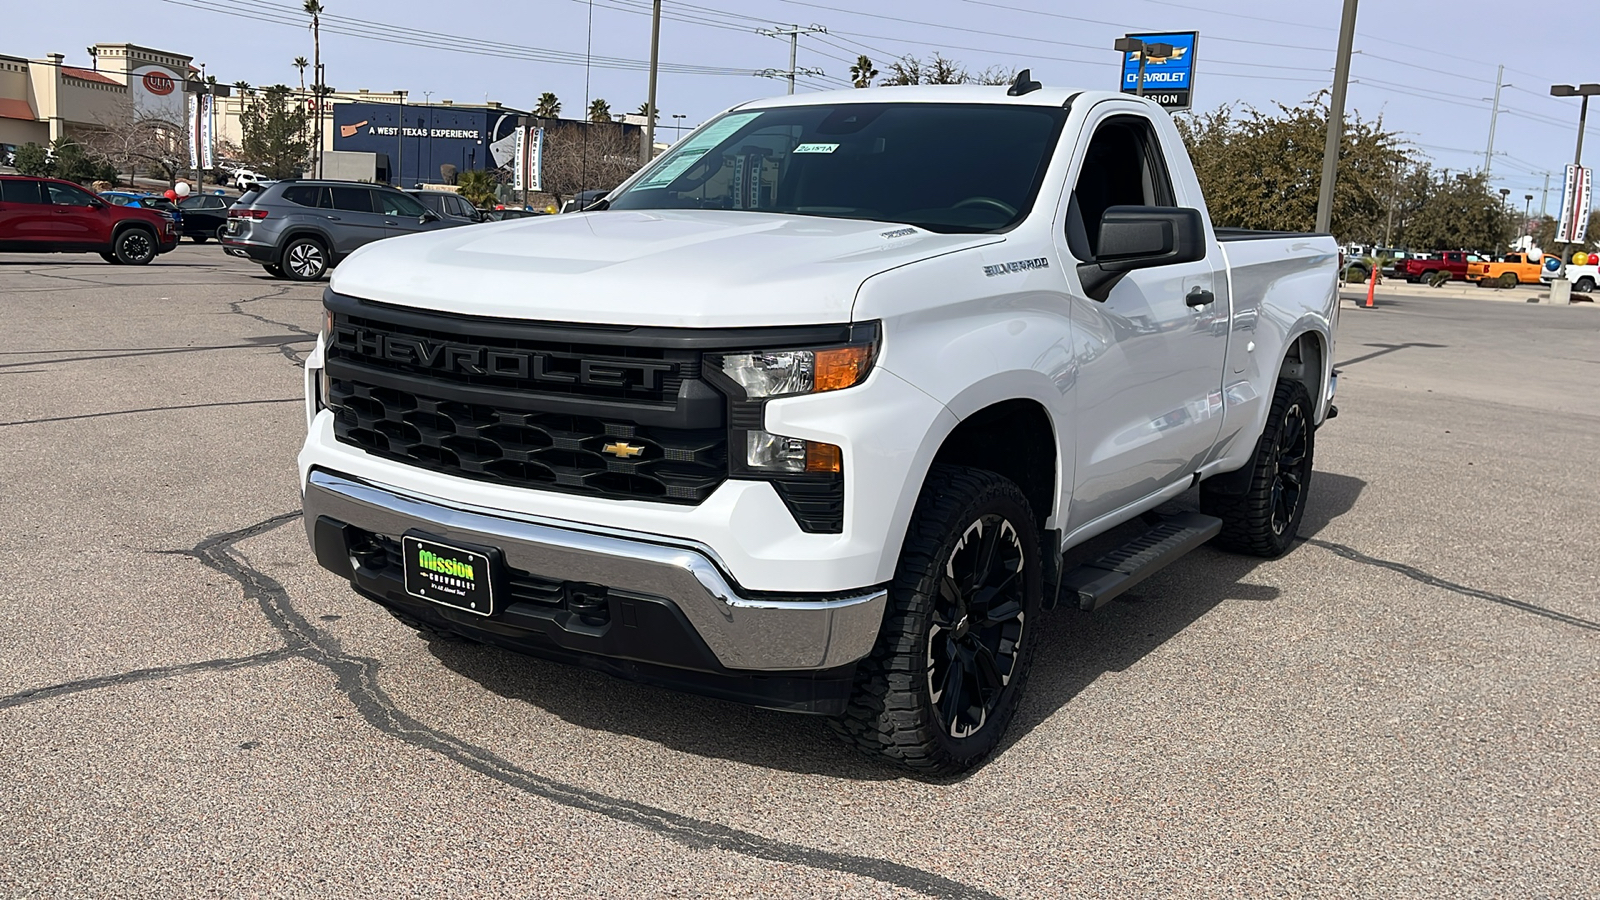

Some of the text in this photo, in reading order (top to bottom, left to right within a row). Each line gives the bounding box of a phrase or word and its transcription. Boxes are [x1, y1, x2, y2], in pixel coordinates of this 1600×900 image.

[368, 126, 375, 135] A
[377, 127, 398, 135] WEST
[402, 127, 428, 137] TEXAS
[532, 130, 540, 187] CERTIFIED
[1560, 167, 1573, 238] CERTIFIED
[1577, 170, 1590, 239] CERTIFIED
[982, 257, 1050, 277] SILVERADO
[332, 326, 681, 392] CHEVROLET
[419, 549, 474, 581] Mission
[429, 573, 475, 591] CHEVROLET
